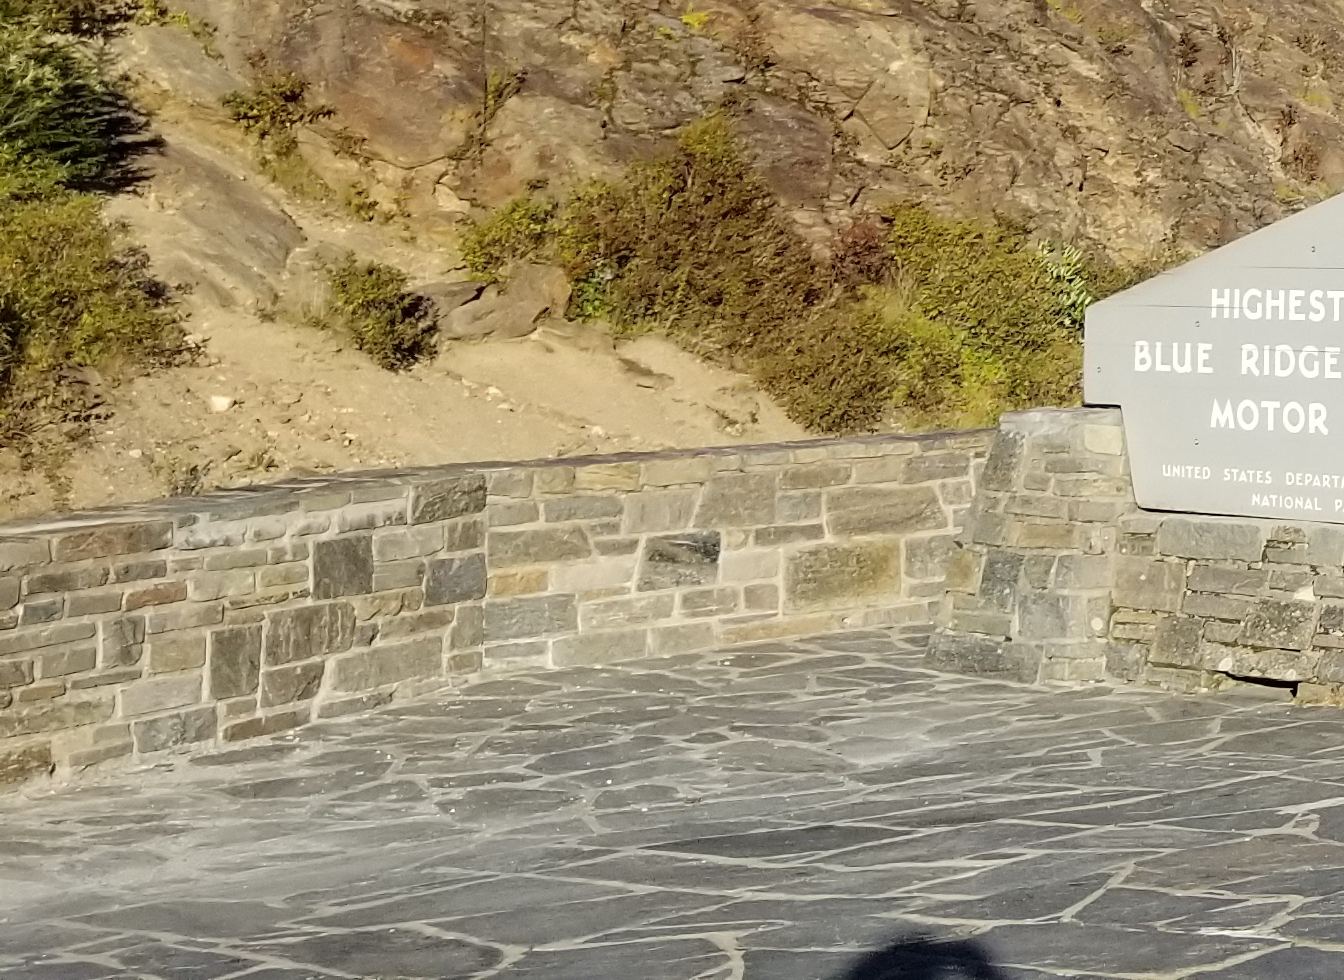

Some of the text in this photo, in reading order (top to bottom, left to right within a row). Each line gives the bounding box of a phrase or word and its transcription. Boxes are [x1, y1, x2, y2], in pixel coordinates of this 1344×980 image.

[1134, 340, 1213, 374] BLUE
[1240, 343, 1341, 379] RIDGE
[1210, 398, 1329, 436] MOTOR
[1162, 464, 1211, 480] UNITED
[1223, 468, 1272, 485] STATES
[1251, 493, 1322, 511] NATIONAL
